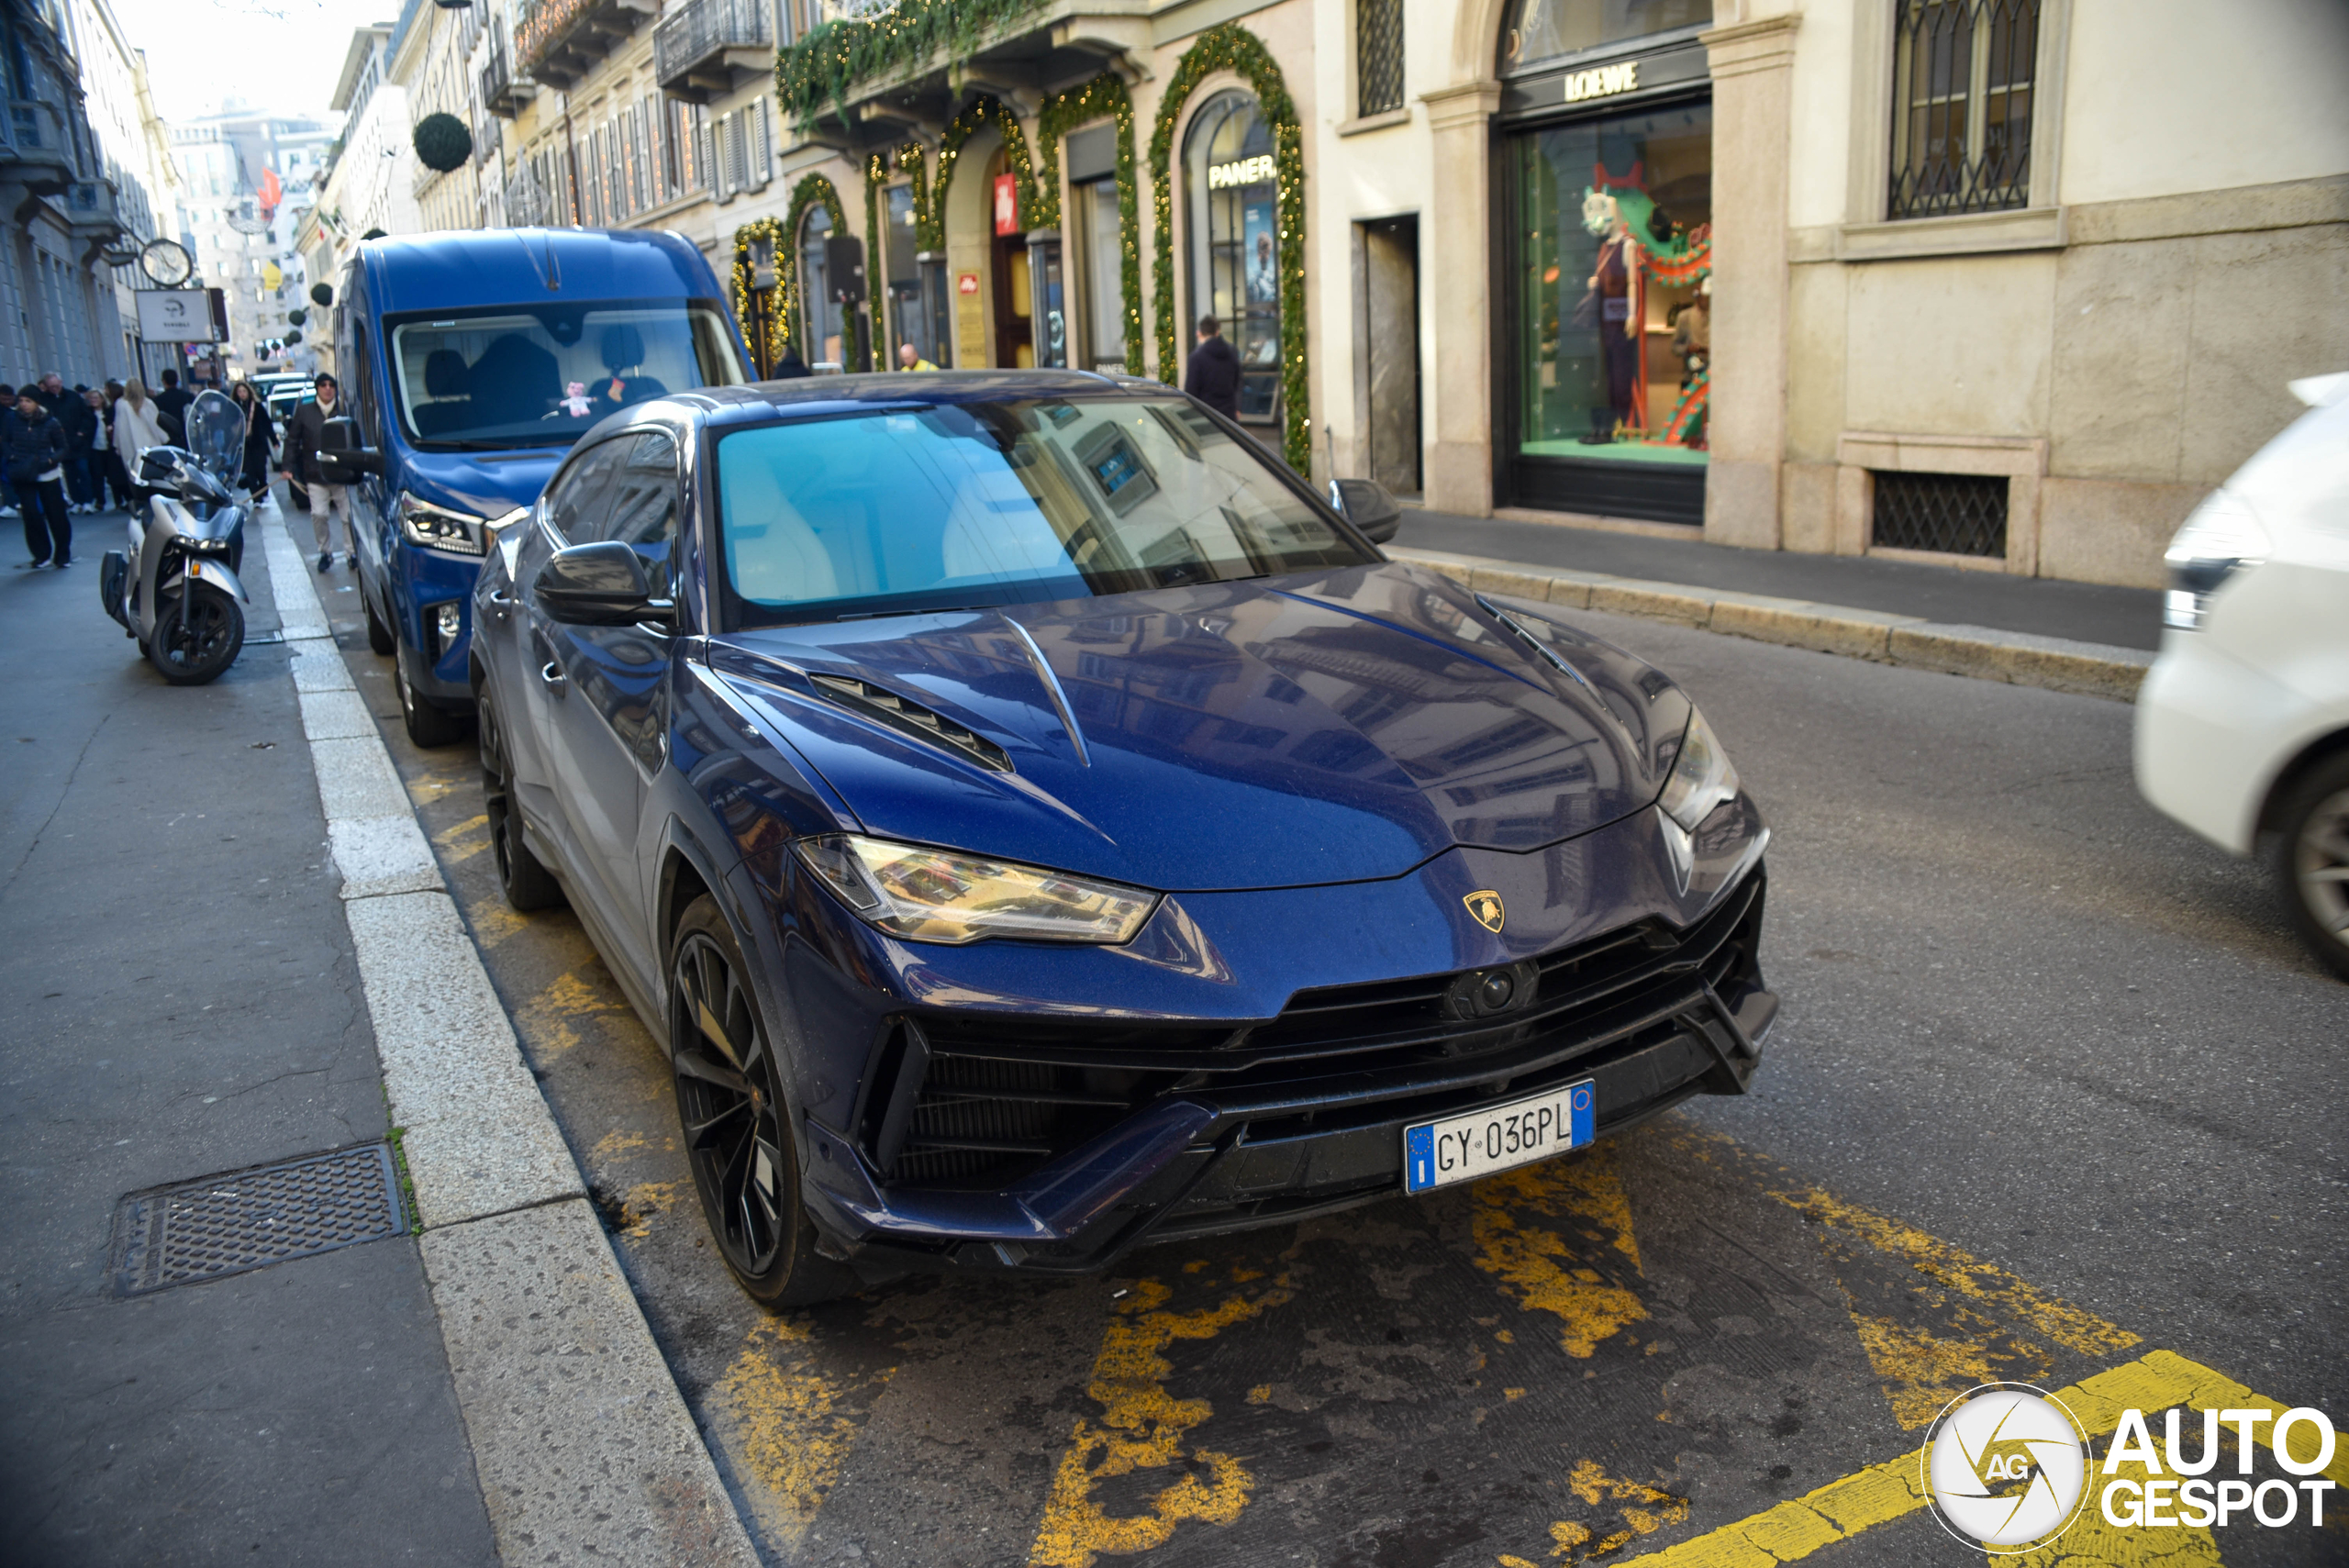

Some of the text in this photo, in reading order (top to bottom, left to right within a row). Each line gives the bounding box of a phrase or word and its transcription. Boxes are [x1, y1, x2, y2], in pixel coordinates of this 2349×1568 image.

[1564, 61, 1638, 102] LOEWE
[1209, 155, 1276, 190] PANER
[1438, 1103, 1570, 1171] GY 036PL
